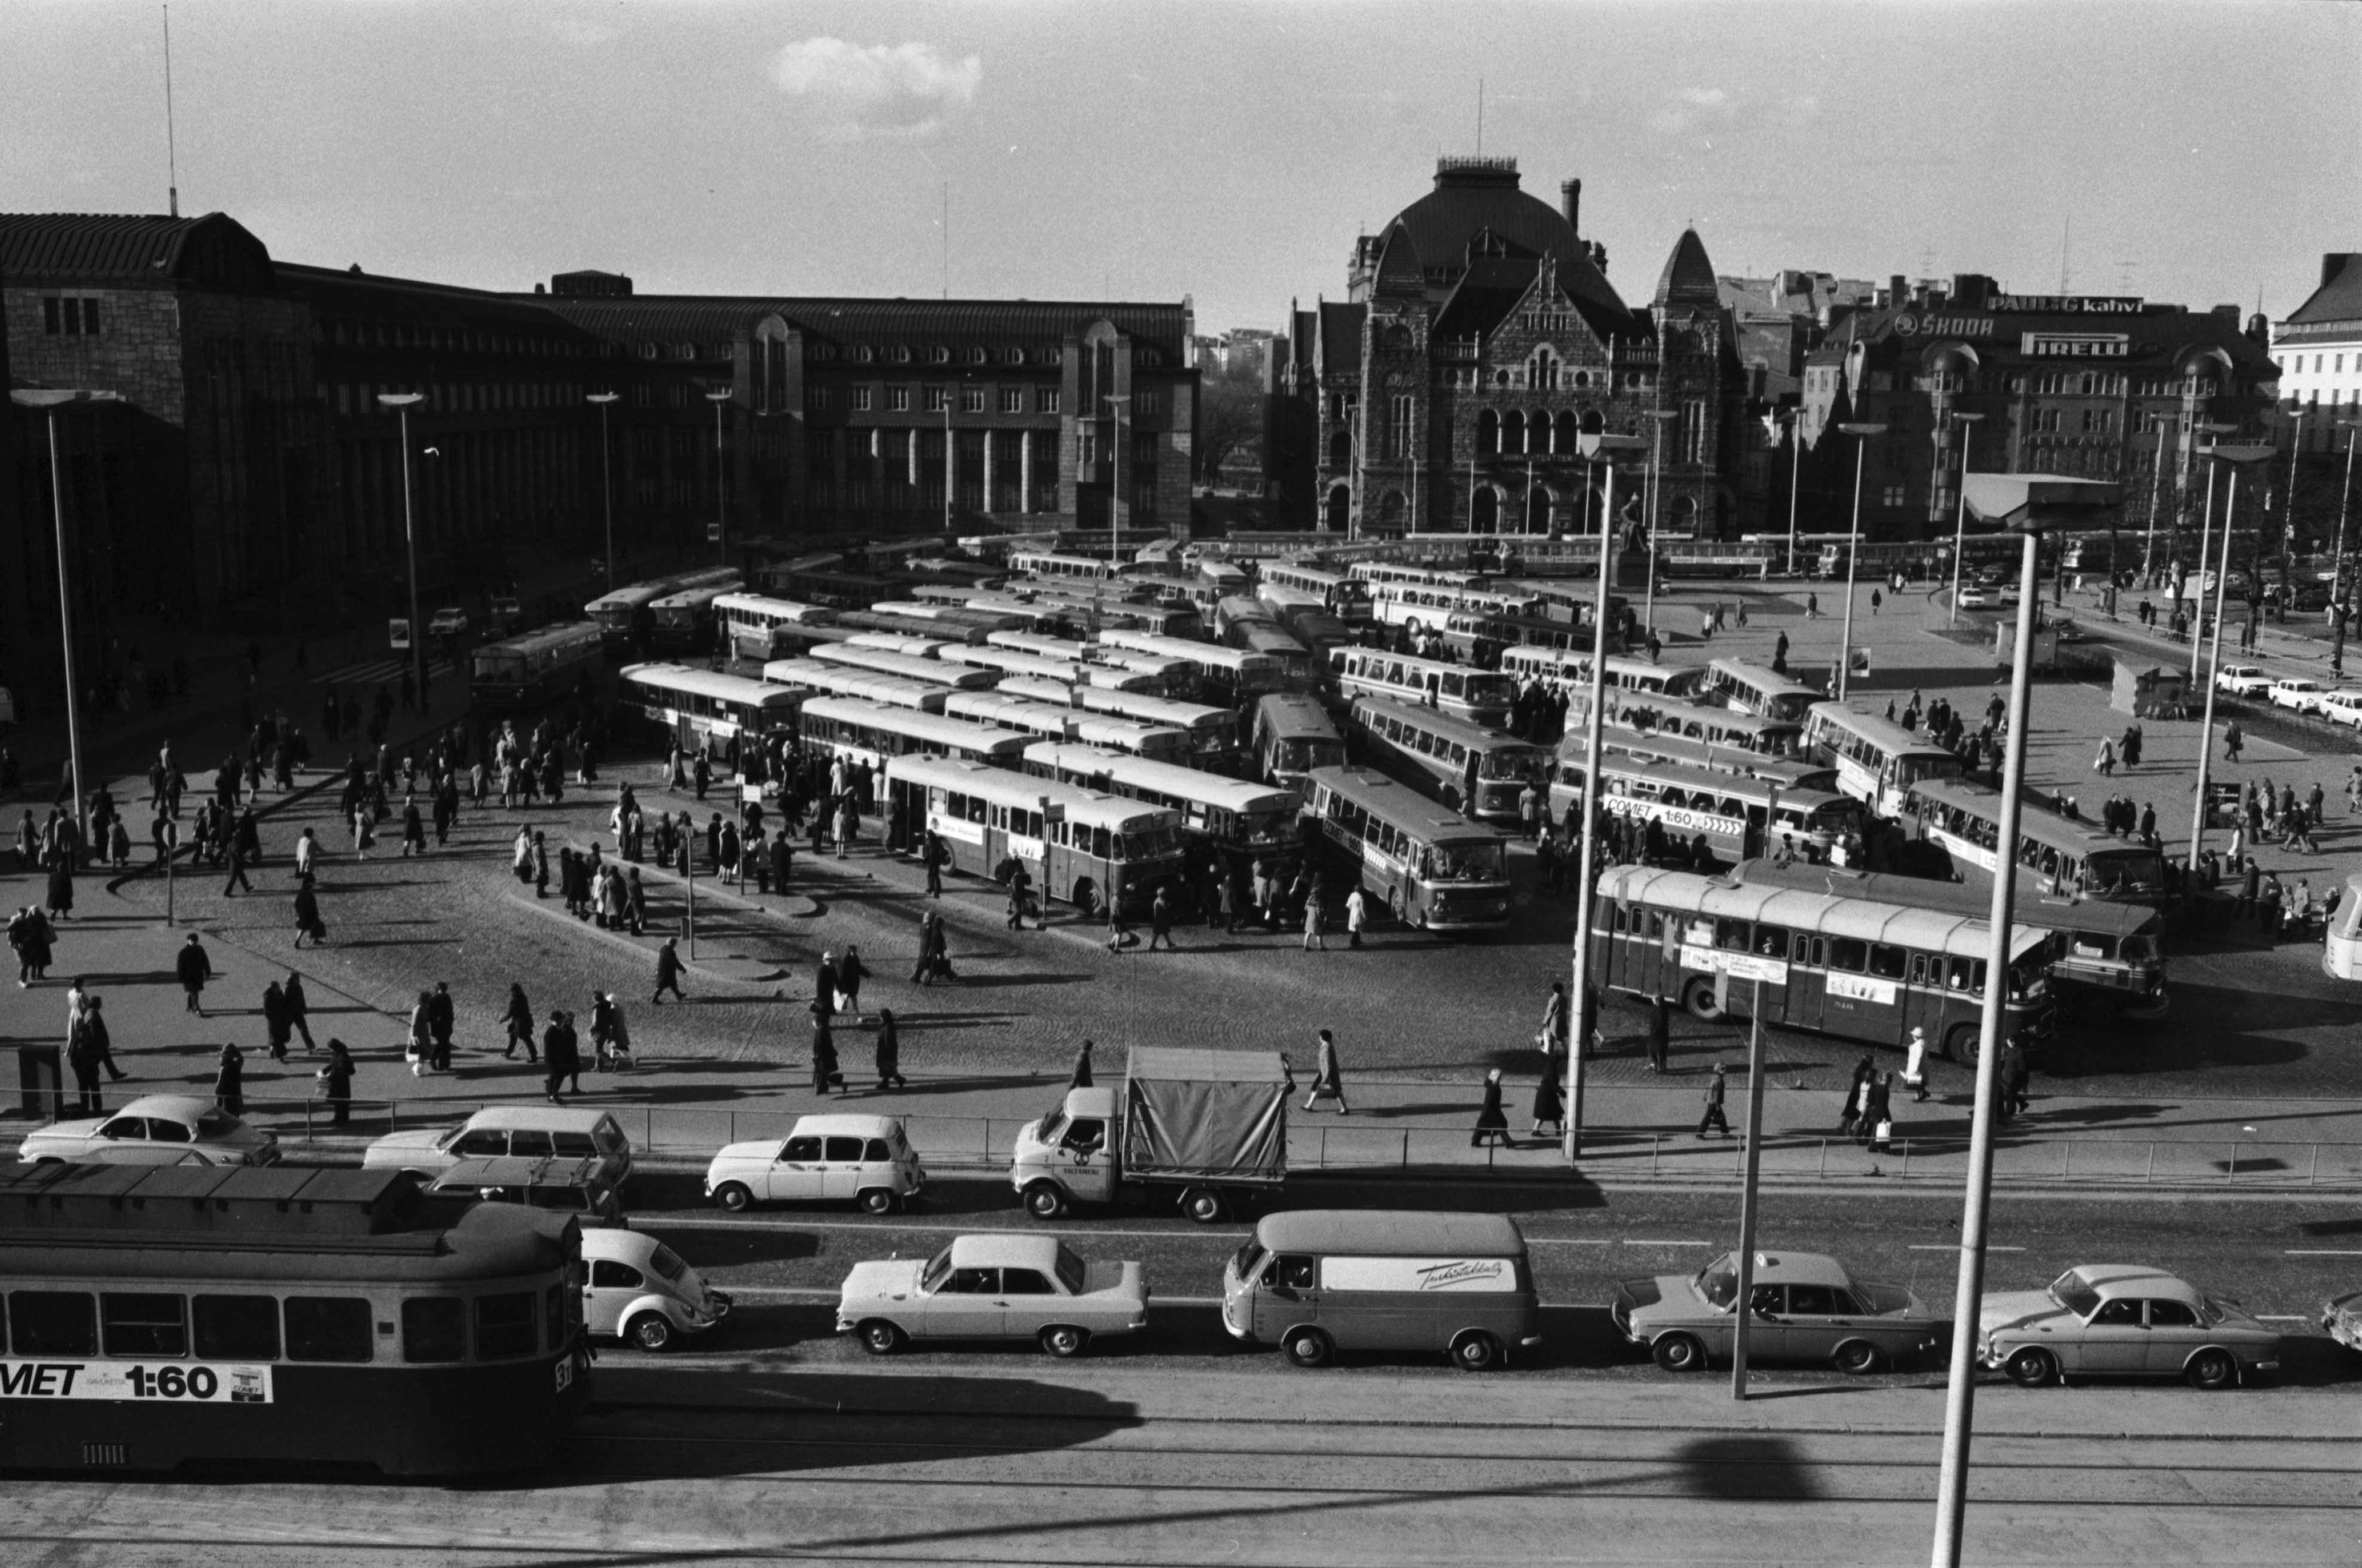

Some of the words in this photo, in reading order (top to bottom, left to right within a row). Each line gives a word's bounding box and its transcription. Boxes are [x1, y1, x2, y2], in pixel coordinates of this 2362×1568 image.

[2083, 298, 2144, 313] kahvi
[1921, 313, 1995, 336] ŠKODA
[2021, 331, 2130, 355] PIRELLI
[1608, 798, 1653, 817] COMET
[1665, 810, 1692, 826] 1:60
[126, 1365, 218, 1399] 1:60
